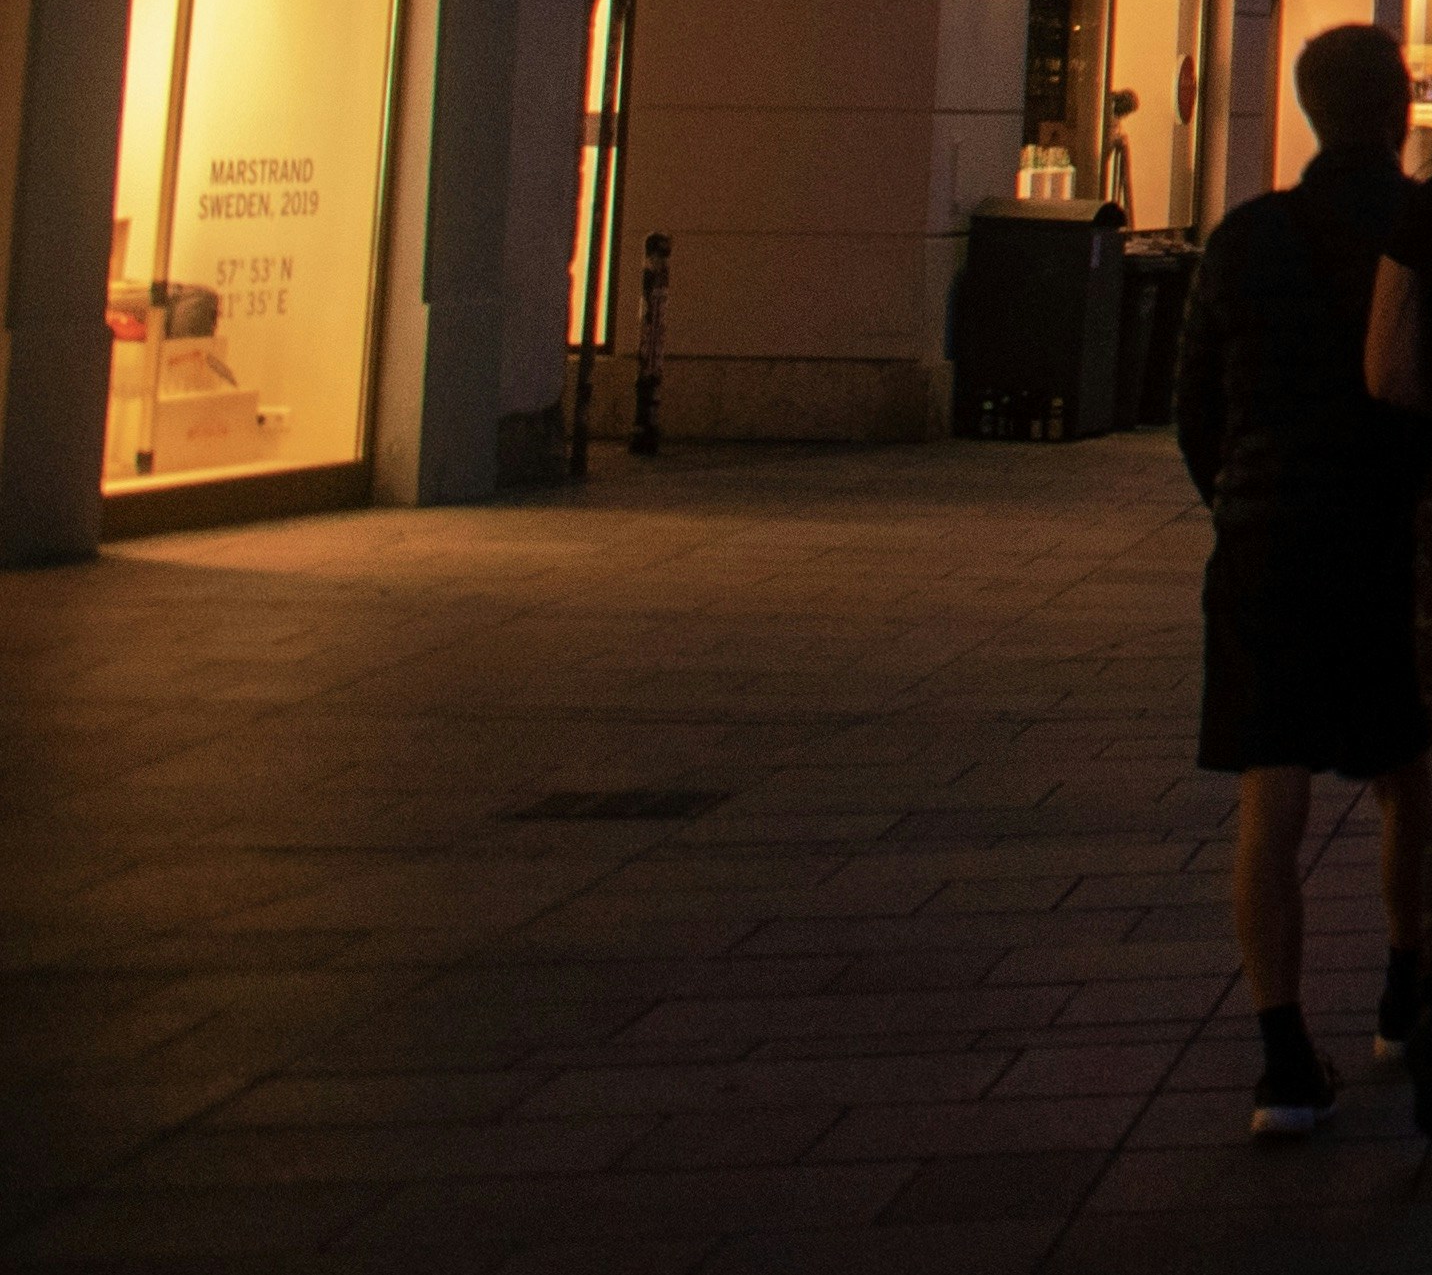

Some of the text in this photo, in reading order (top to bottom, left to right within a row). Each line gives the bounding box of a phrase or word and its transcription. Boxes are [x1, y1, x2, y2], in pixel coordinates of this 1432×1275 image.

[211, 157, 314, 185] MARSTRAND
[198, 189, 320, 221] SWEDEN, 2019
[280, 256, 293, 281] N
[277, 287, 289, 315] E
